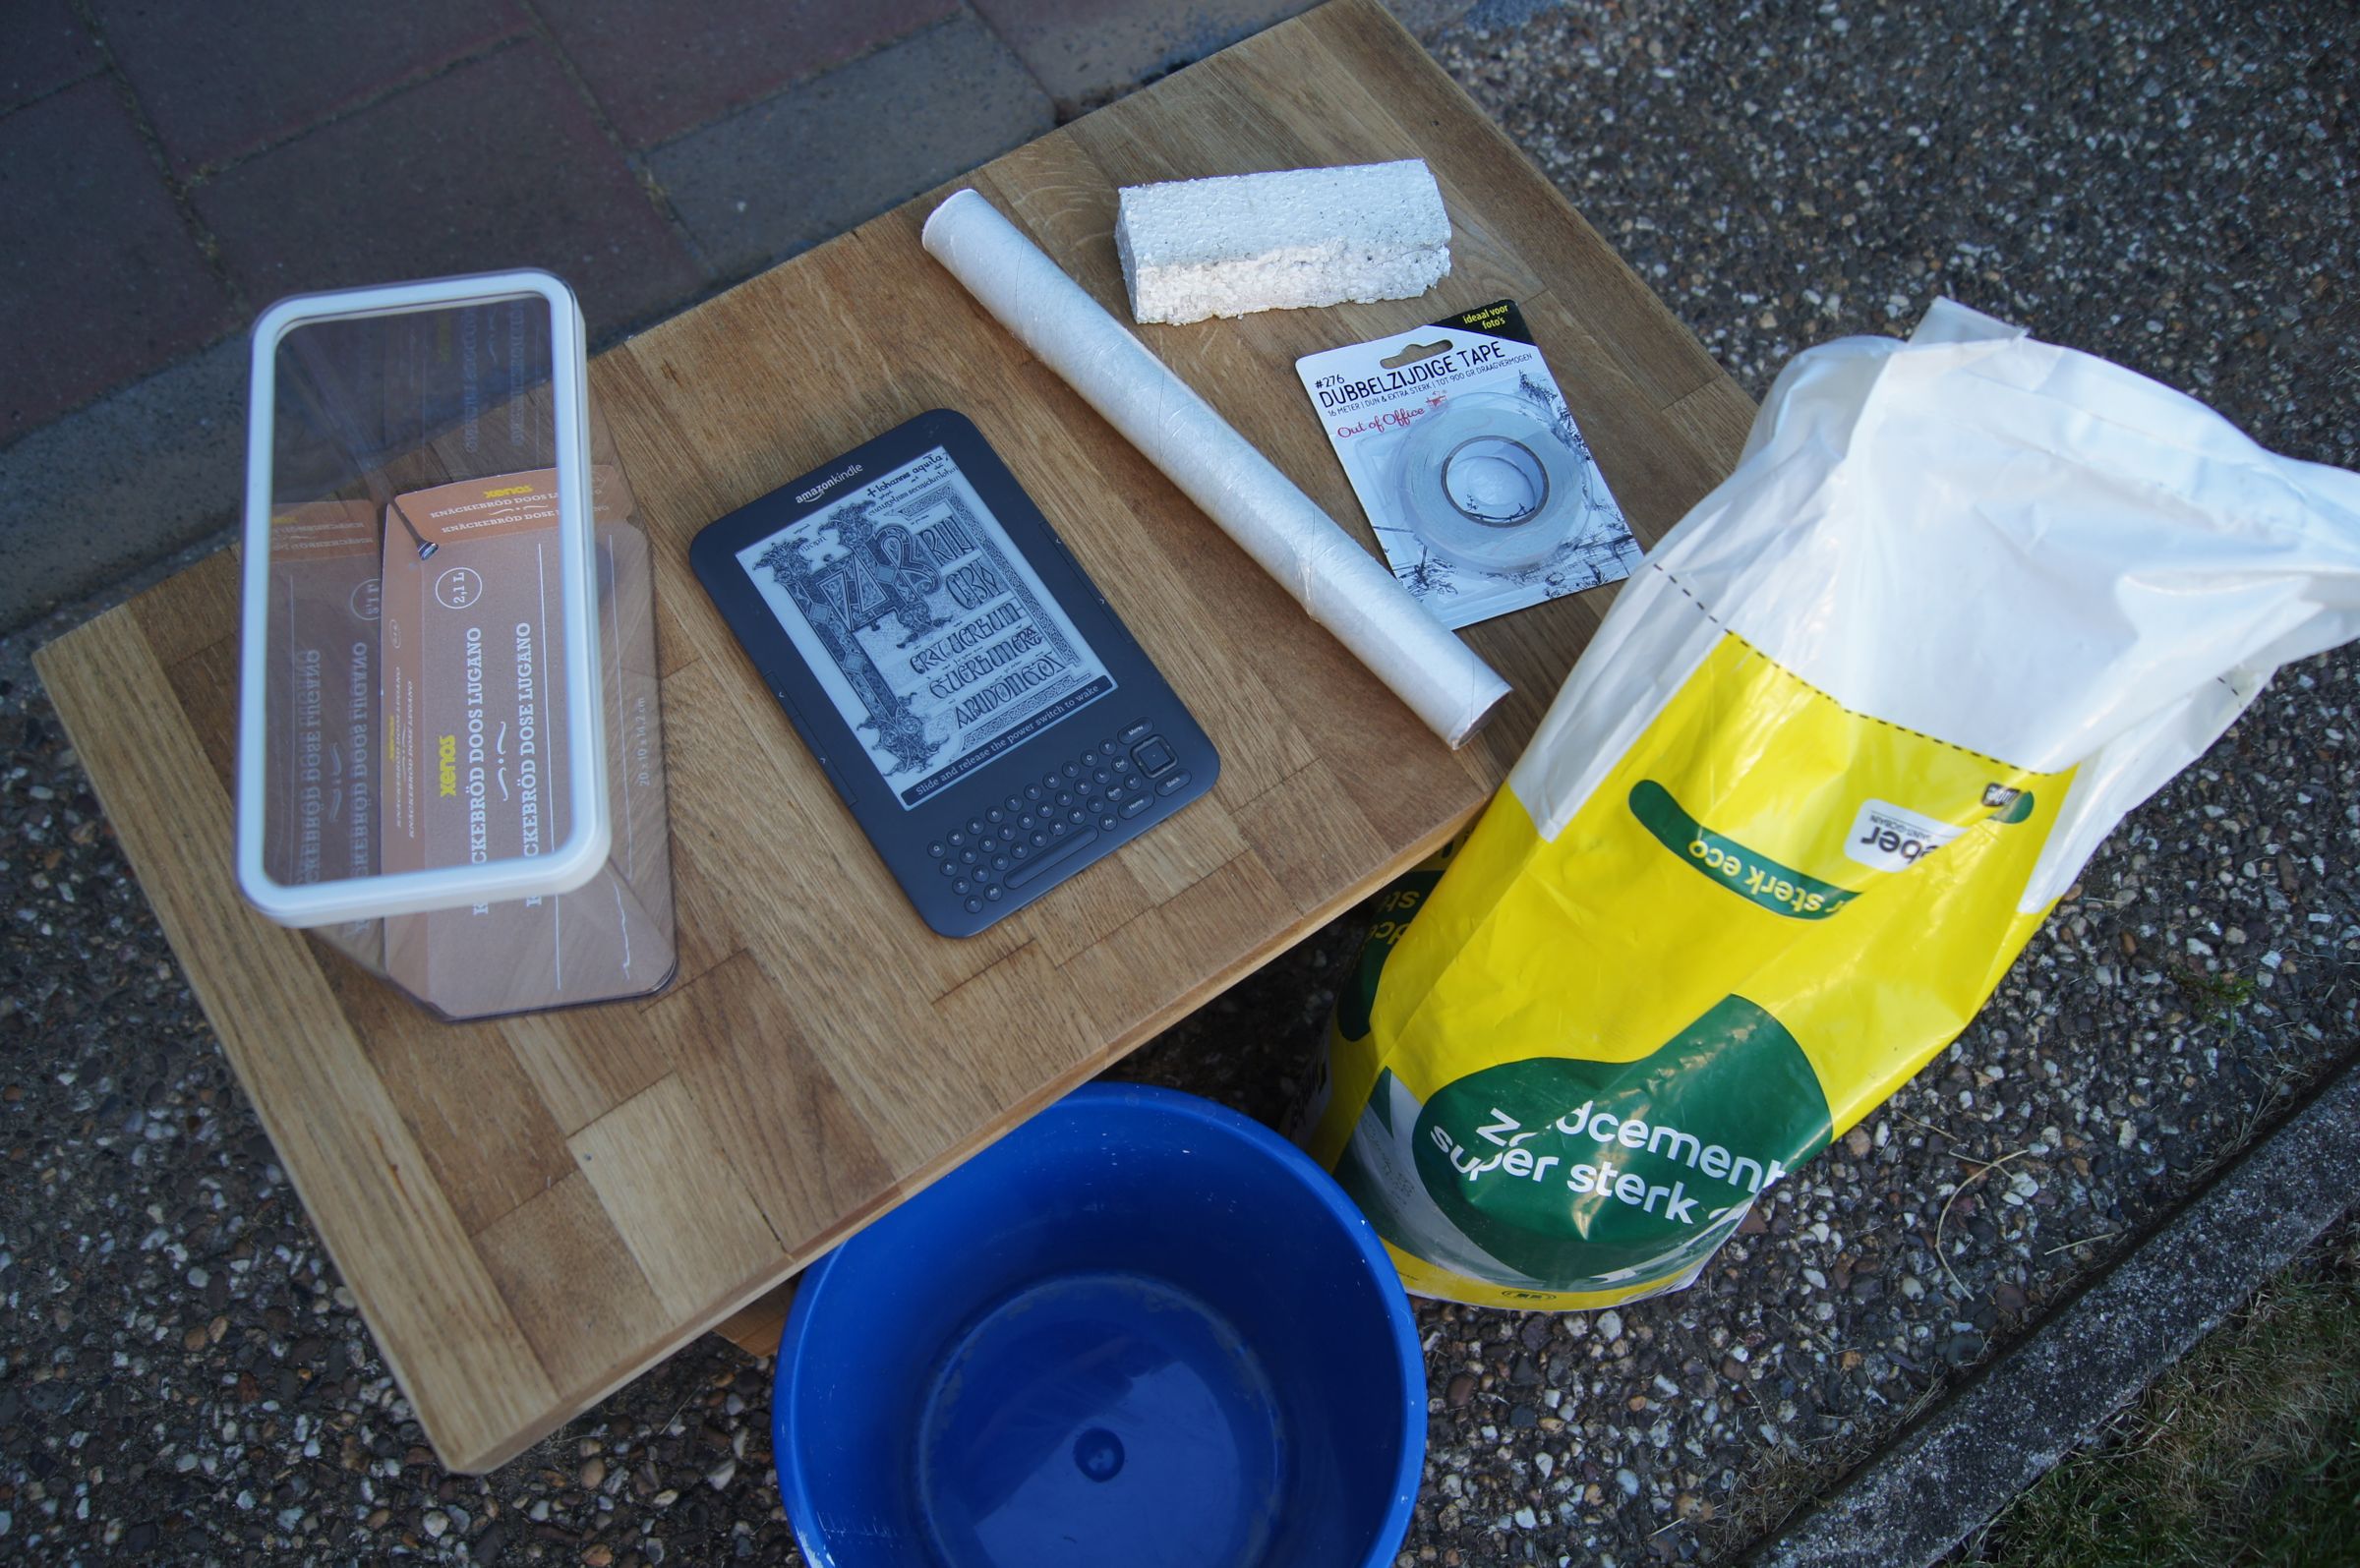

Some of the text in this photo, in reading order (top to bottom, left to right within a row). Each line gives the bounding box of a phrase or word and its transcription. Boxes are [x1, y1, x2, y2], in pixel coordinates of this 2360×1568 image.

[1462, 304, 1508, 325] ideaal voor
[1482, 316, 1505, 330] foto's
[1315, 374, 1345, 389] #276
[1319, 341, 1505, 408] DUBBELZIJDIGE TAPE
[1337, 403, 1360, 415] METER
[1365, 397, 1380, 409] DUN
[1387, 390, 1409, 401] EXTRA
[1409, 383, 1432, 395] STERK
[1435, 377, 1449, 388] TOT
[1449, 373, 1465, 383] 900
[1466, 369, 1476, 378] GR
[1476, 353, 1533, 376] DRAAGVERMOGEN
[1337, 407, 1426, 438] Out of Office
[514, 494, 547, 504] DOOS
[524, 510, 556, 521] DOSE
[439, 734, 456, 797] xenos
[515, 622, 542, 906] KCKEBRÖD DOSE LUGANO
[915, 684, 1099, 795] Slide and release the power switch to wake
[465, 627, 489, 915] KCKEBRÖD DOOS LUGANO
[1688, 840, 1825, 912] sterk eco
[1860, 826, 1940, 864] ber
[1475, 1100, 1786, 1193] Zdcement
[1566, 1161, 1699, 1225] sterk
